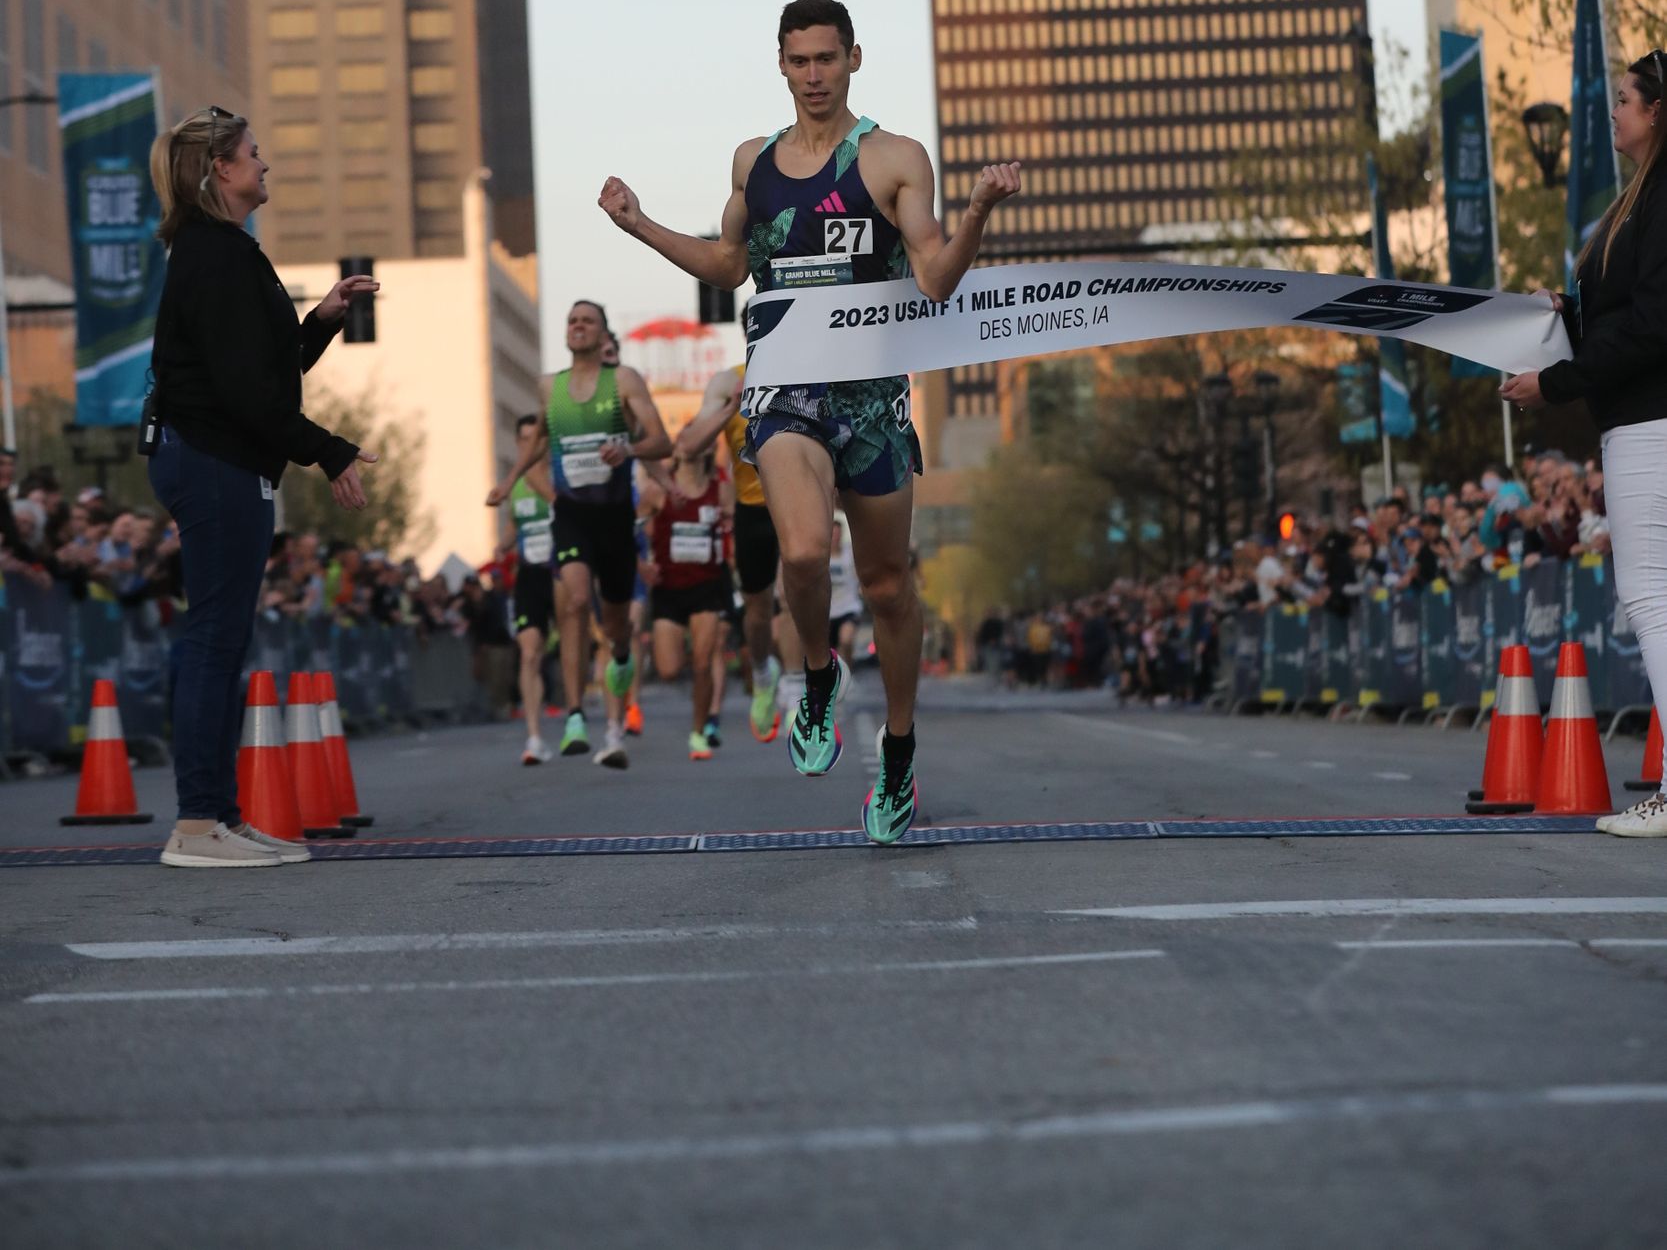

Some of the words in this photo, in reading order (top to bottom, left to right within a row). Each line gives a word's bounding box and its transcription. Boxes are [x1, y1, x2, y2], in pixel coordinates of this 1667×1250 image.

[827, 220, 867, 254] 27
[829, 305, 889, 329] 2023
[895, 299, 950, 322] USATF
[956, 294, 964, 313] 1
[971, 287, 1016, 312] MILE
[1022, 280, 1082, 305] ROAD
[1087, 277, 1288, 297] CHAMPIONSHIPS
[979, 317, 1012, 341] DES
[1017, 307, 1088, 335] MOINES,
[1092, 305, 1109, 325] IA
